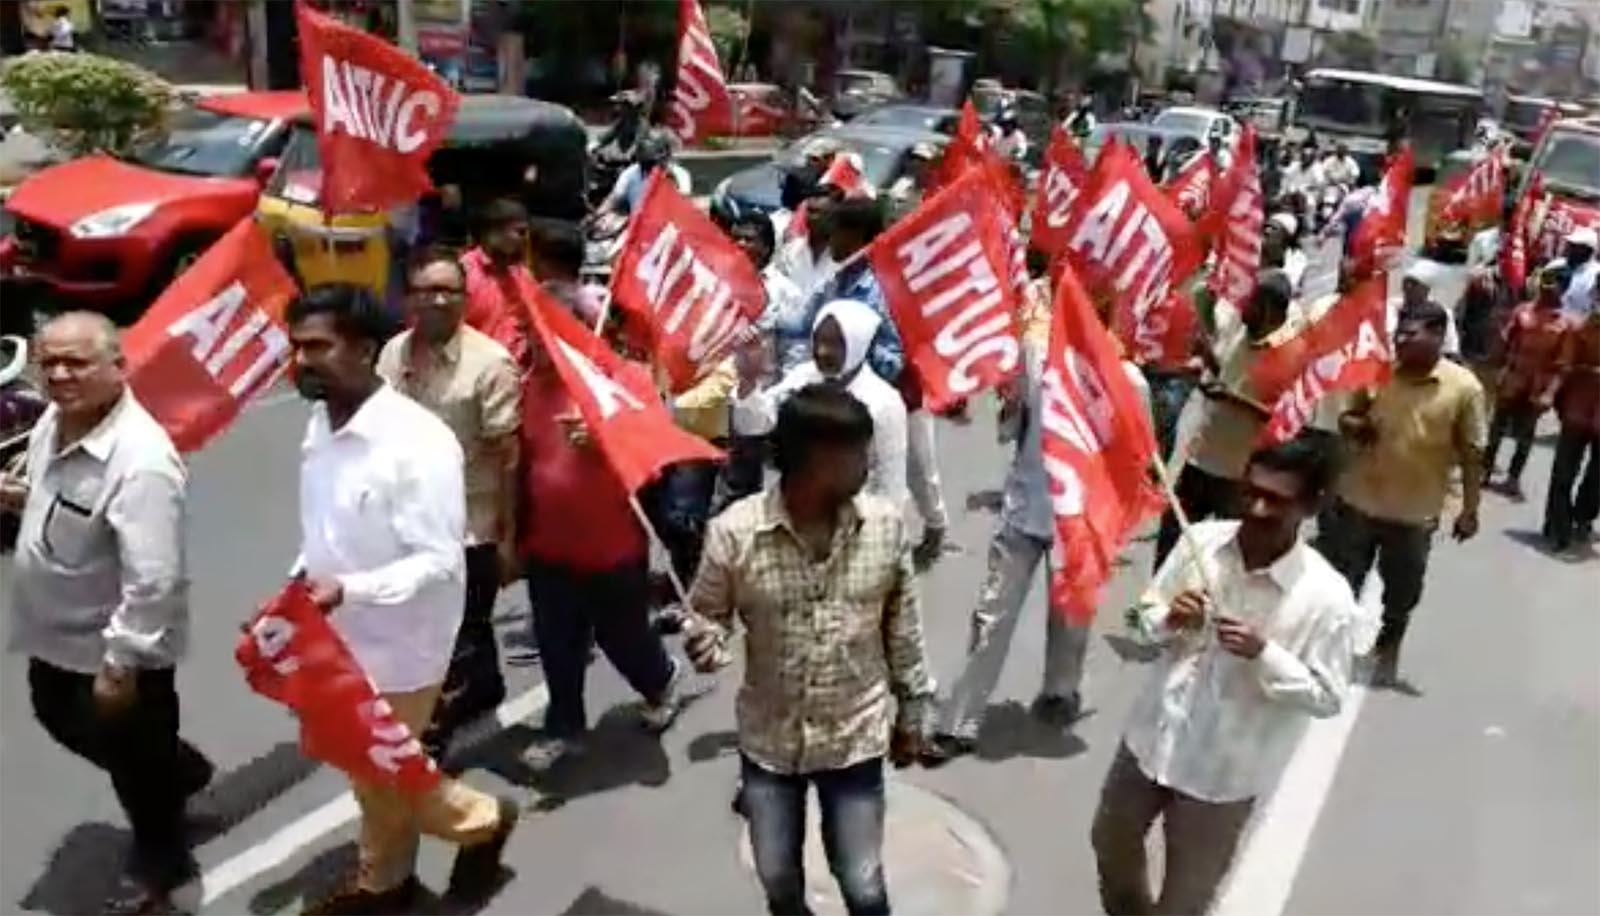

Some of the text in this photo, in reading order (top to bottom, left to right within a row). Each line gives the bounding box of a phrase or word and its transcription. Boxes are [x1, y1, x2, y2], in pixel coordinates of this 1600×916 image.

[323, 54, 441, 153] AITUC
[635, 222, 750, 362] AITU
[897, 211, 1019, 393] AITUC
